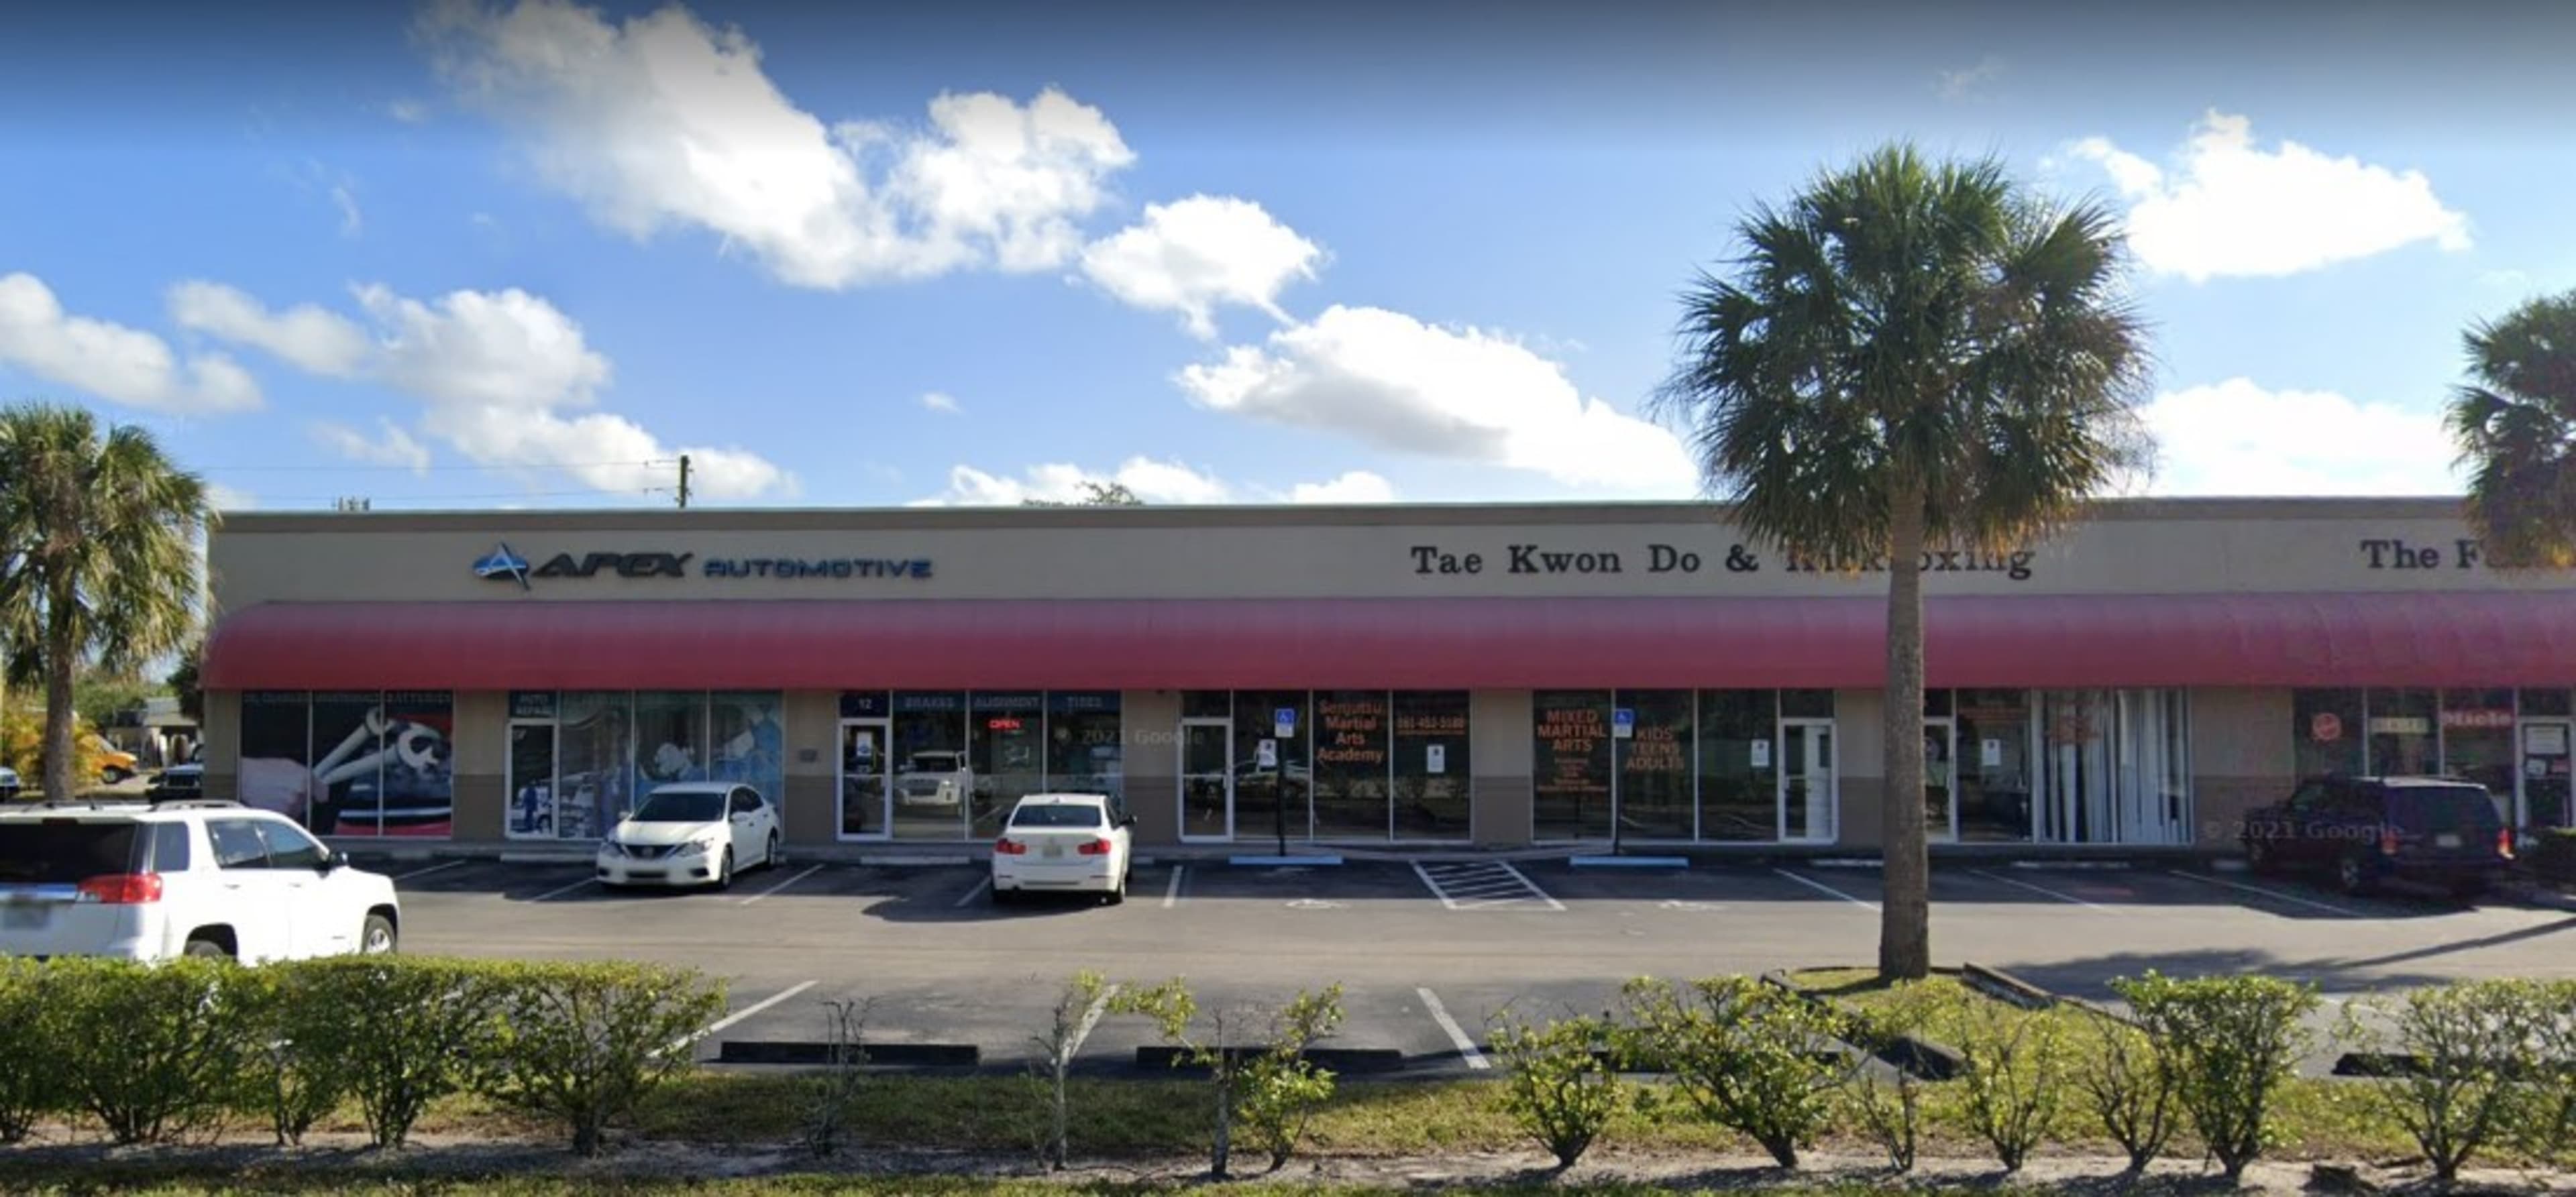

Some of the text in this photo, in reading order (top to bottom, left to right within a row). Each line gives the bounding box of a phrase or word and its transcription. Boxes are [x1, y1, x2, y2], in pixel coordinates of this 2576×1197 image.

[1411, 545, 1483, 574] Tae
[1507, 545, 1623, 574] Kwon
[1648, 545, 1701, 574] Do
[1725, 545, 1759, 573] &
[2359, 539, 2440, 569] The
[533, 553, 934, 579] APEX AUTOMOTIVE
[904, 697, 955, 709] BRAKES
[987, 718, 1020, 729] OPEN
[1325, 716, 1377, 730] Martial
[1546, 709, 1598, 724] MIXED
[1334, 731, 1366, 745] Arts
[1537, 724, 1608, 738] MARTIAL
[1636, 726, 1674, 741] KIDS
[1552, 738, 1593, 752] ARTS
[1317, 747, 1384, 763] Academy
[1625, 756, 1684, 770] ADULTS
